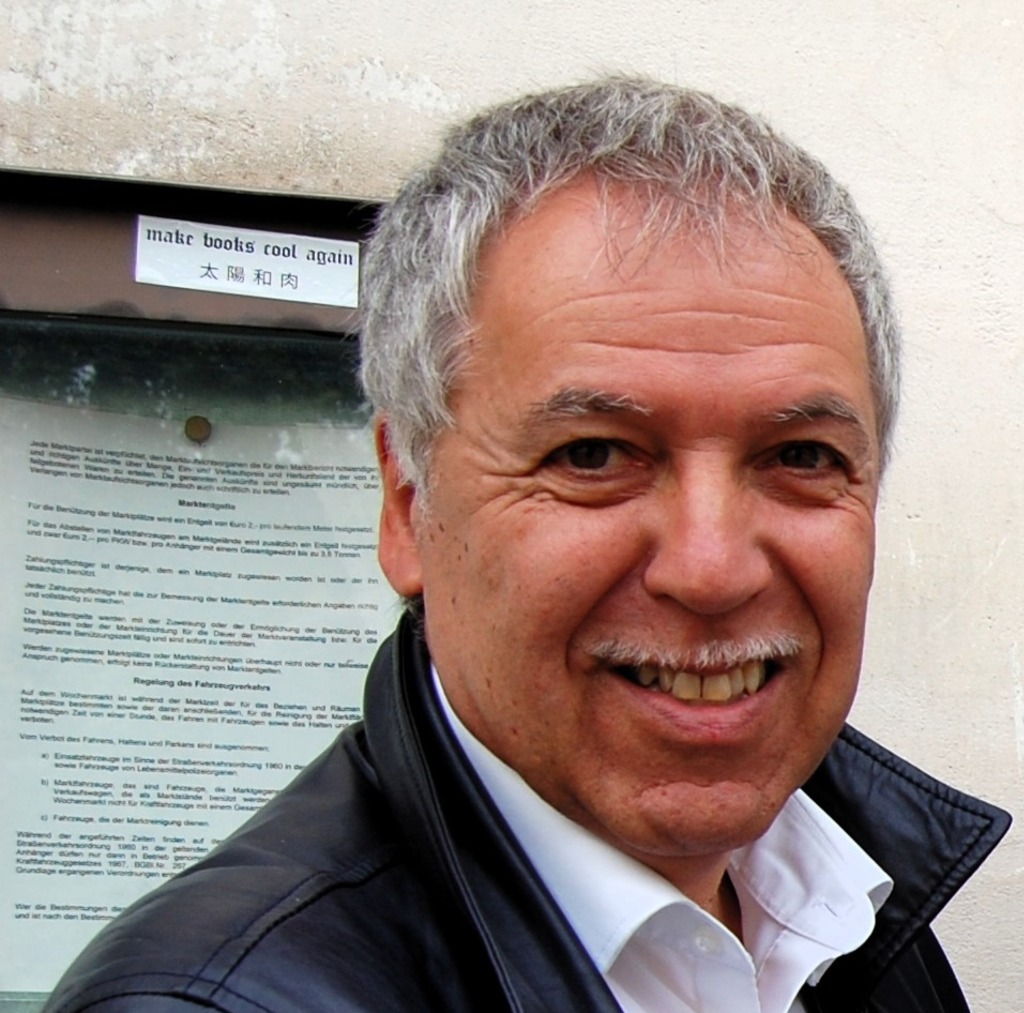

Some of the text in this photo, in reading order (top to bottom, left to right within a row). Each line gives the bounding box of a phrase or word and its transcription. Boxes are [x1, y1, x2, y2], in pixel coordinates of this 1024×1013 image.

[147, 228, 354, 266] make books cool again
[200, 262, 298, 290] 太陽和肉
[134, 676, 175, 687] Regelung
[195, 680, 271, 692] Fahrzeugverkehrs
